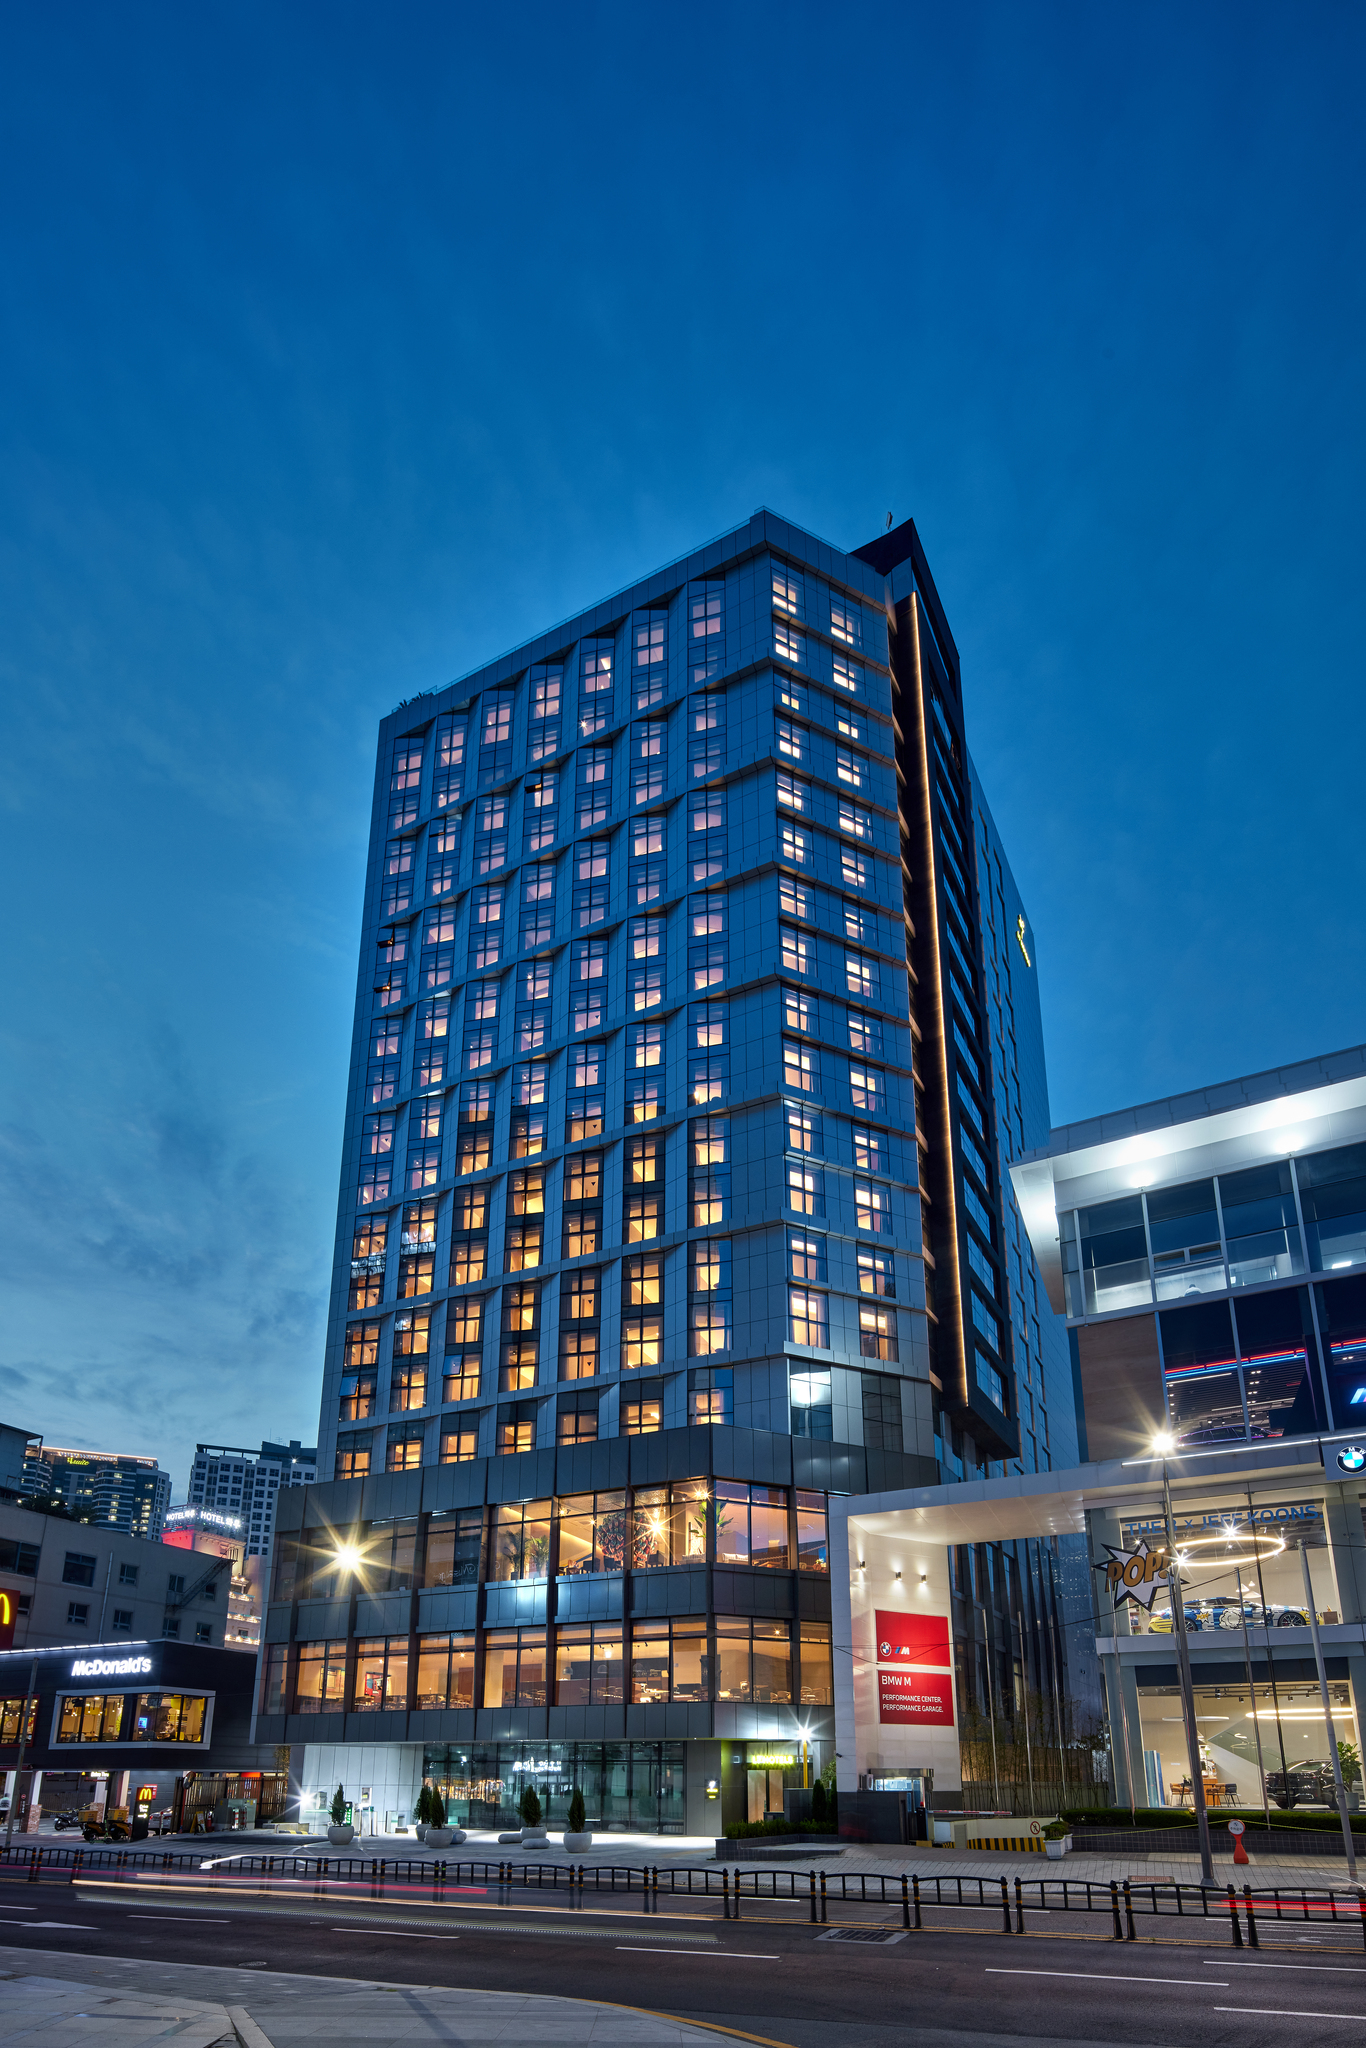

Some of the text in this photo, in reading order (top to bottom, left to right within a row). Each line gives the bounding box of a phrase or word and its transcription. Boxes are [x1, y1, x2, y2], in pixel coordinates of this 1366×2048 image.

[166, 1512, 184, 1521] HOTEL
[200, 1511, 225, 1525] HOTEL
[1124, 1520, 1163, 1536] THE
[1200, 1512, 1242, 1531] JEFF
[1247, 1505, 1323, 1525] KOONS.
[71, 1656, 152, 1676] McDonald's
[881, 1675, 912, 1686] BMW M
[882, 1693, 920, 1702] PERFORMANCE
[882, 1703, 921, 1712] PERFORMANCE
